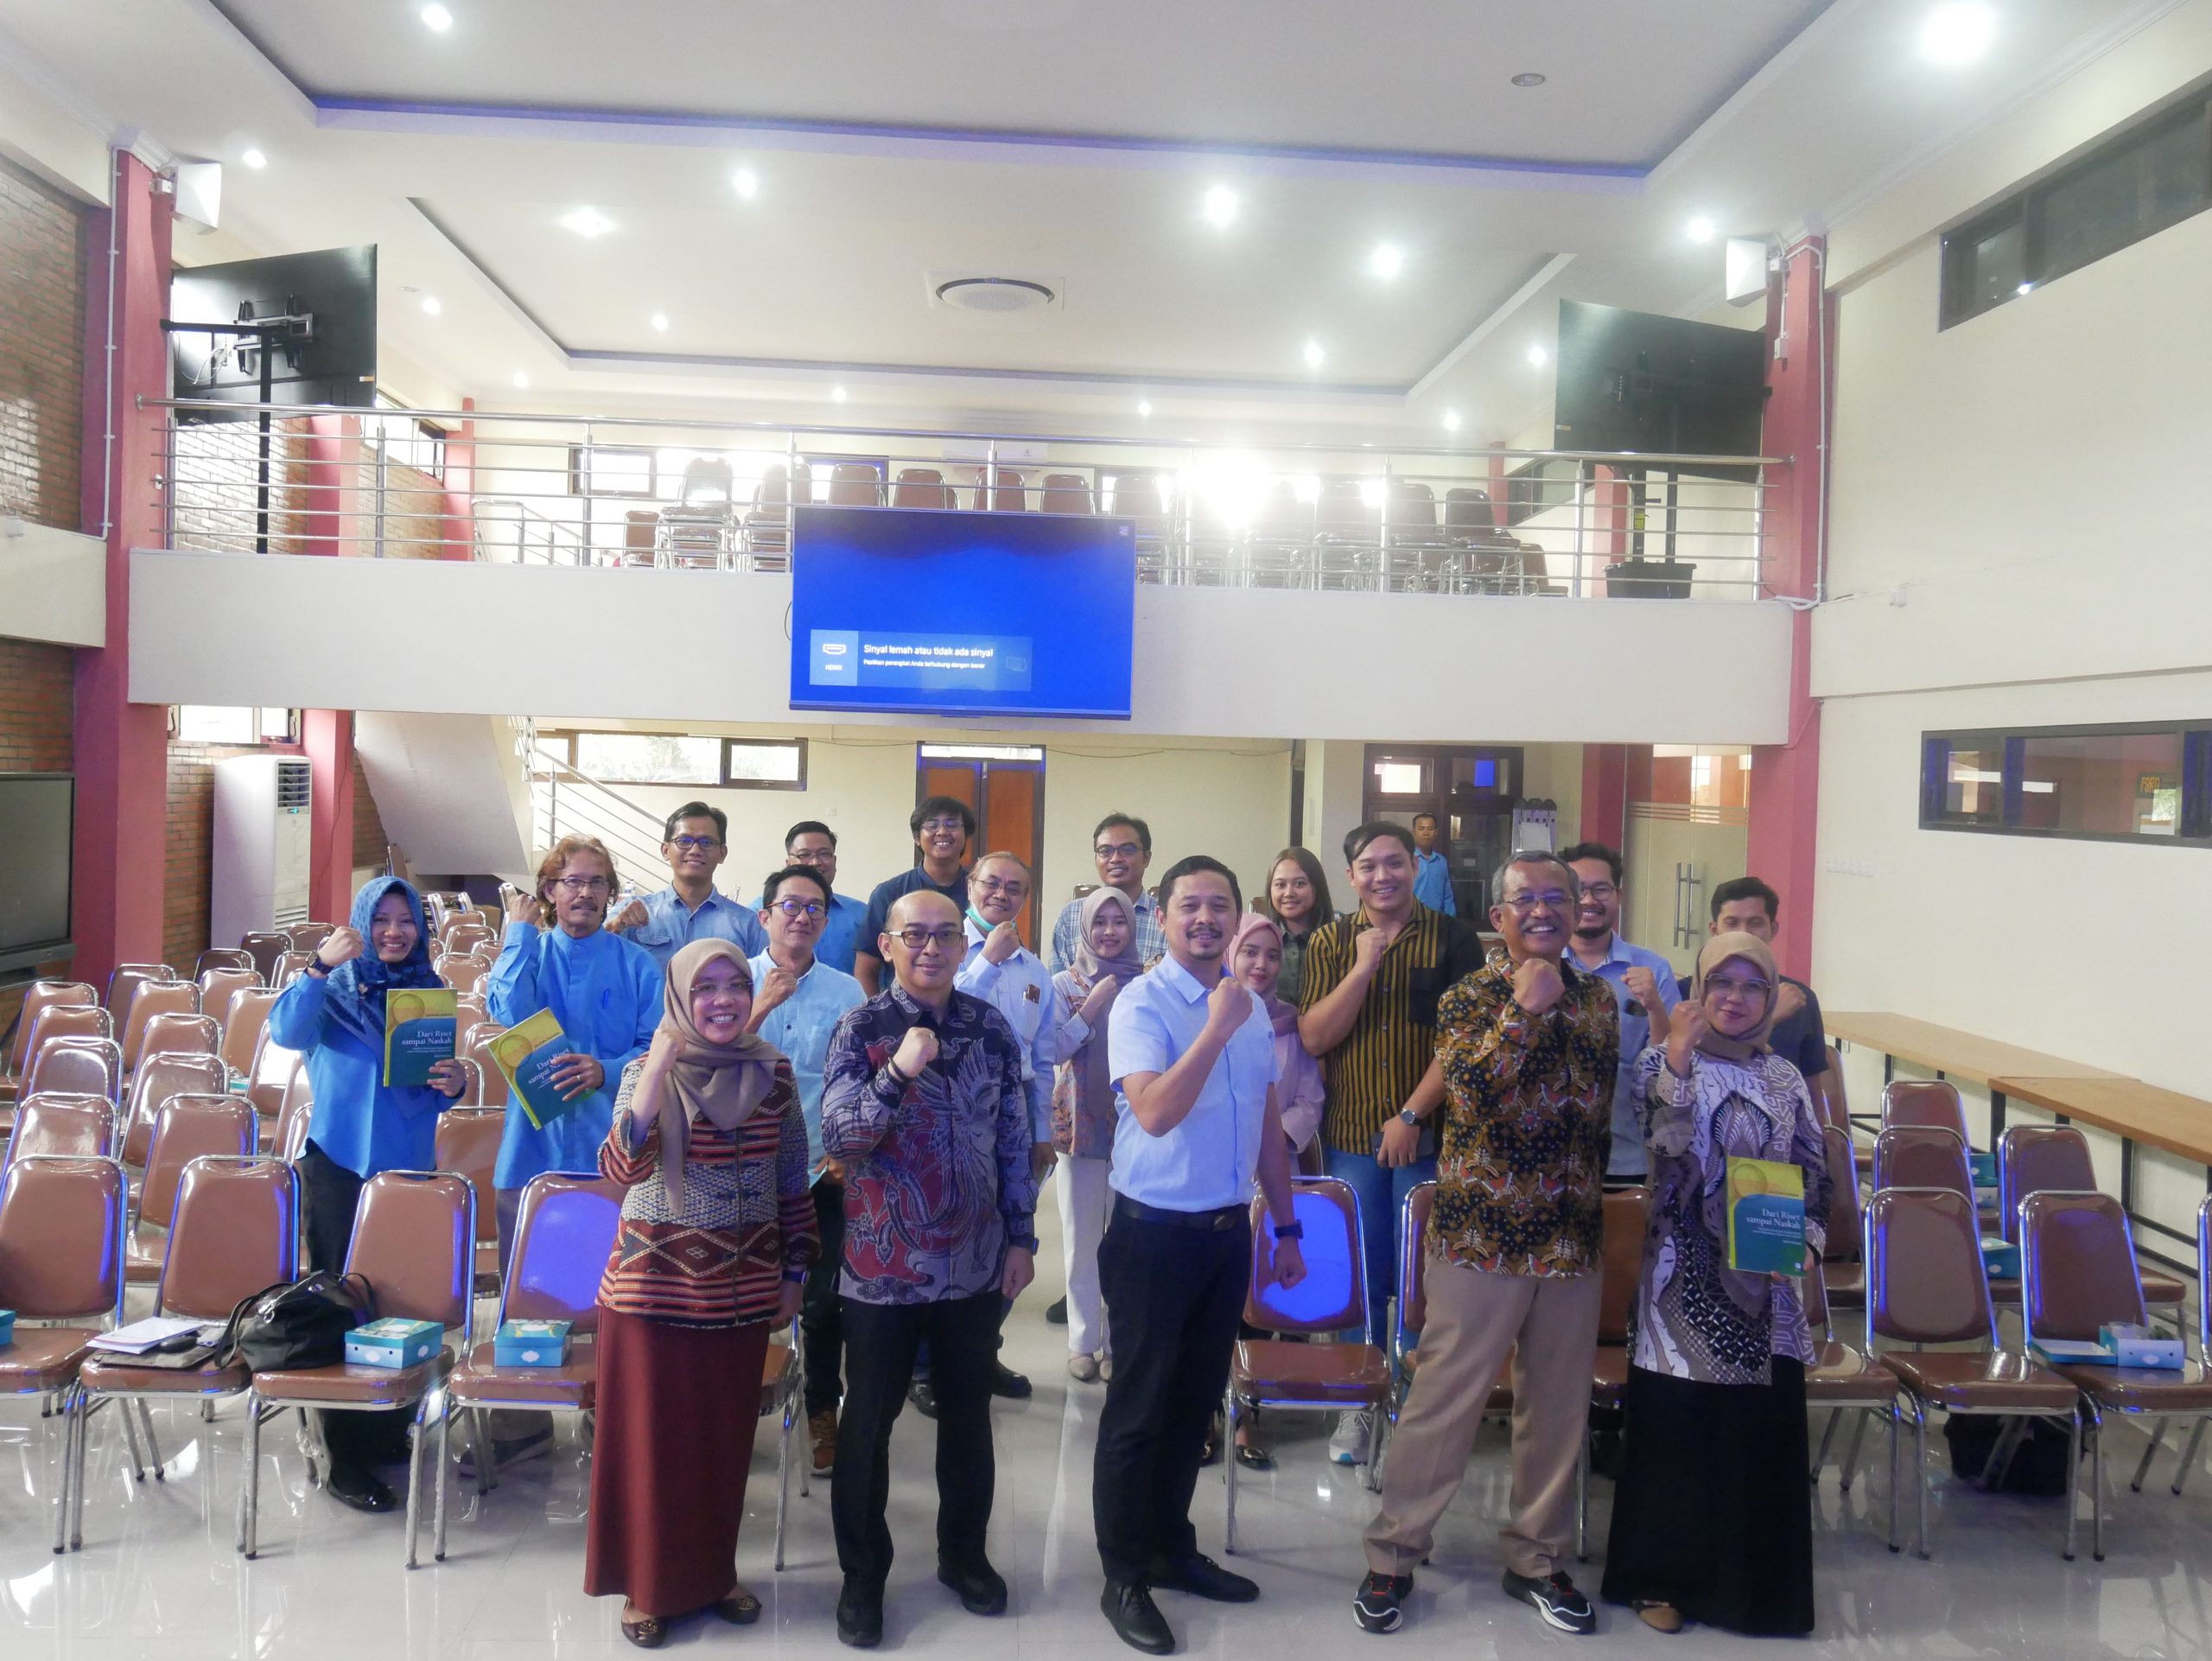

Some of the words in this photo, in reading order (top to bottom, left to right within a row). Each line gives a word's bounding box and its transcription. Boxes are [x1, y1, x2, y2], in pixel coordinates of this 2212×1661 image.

[864, 644, 887, 655] Sinyal
[889, 645, 912, 654] lemah
[914, 646, 932, 655] atau
[933, 646, 953, 656] tidak
[955, 647, 969, 657] ada
[970, 648, 994, 659] sinyal
[401, 1038, 426, 1047] sampai
[427, 1036, 452, 1045] Naskah
[528, 1067, 550, 1085] sampai
[1762, 1207, 1779, 1218] Dari
[1781, 1211, 1801, 1220] Riset
[1745, 1216, 1772, 1227] sampai
[1773, 1219, 1802, 1230] Naskah
